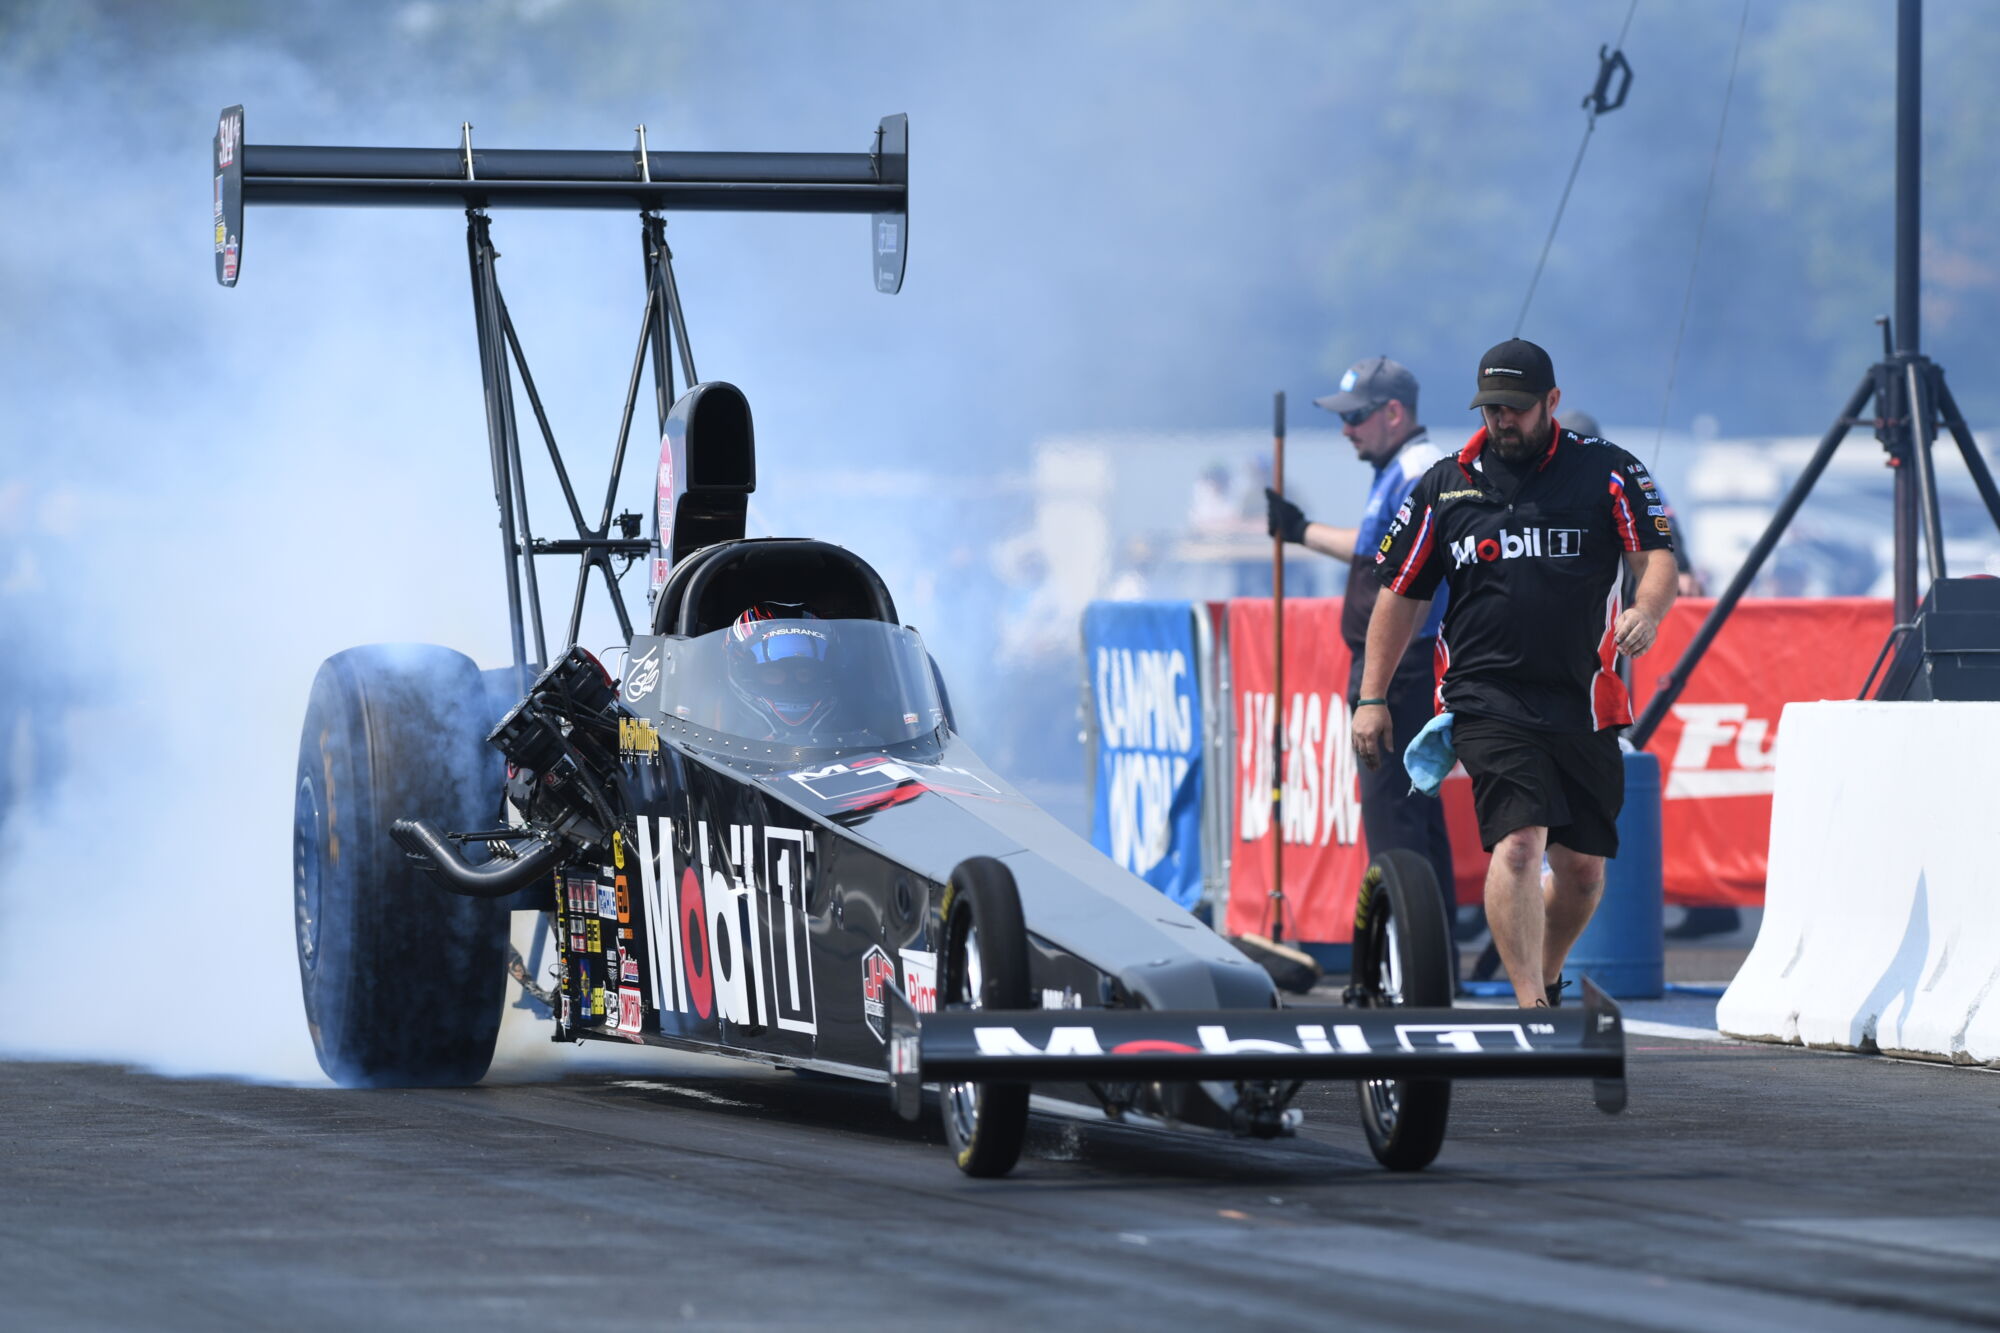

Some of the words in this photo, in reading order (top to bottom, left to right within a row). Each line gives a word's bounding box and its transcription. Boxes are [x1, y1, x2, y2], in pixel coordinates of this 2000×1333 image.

[1450, 527, 1541, 570] Mobil
[637, 815, 768, 1027] Mobil
[974, 1025, 1372, 1056] Mobil
